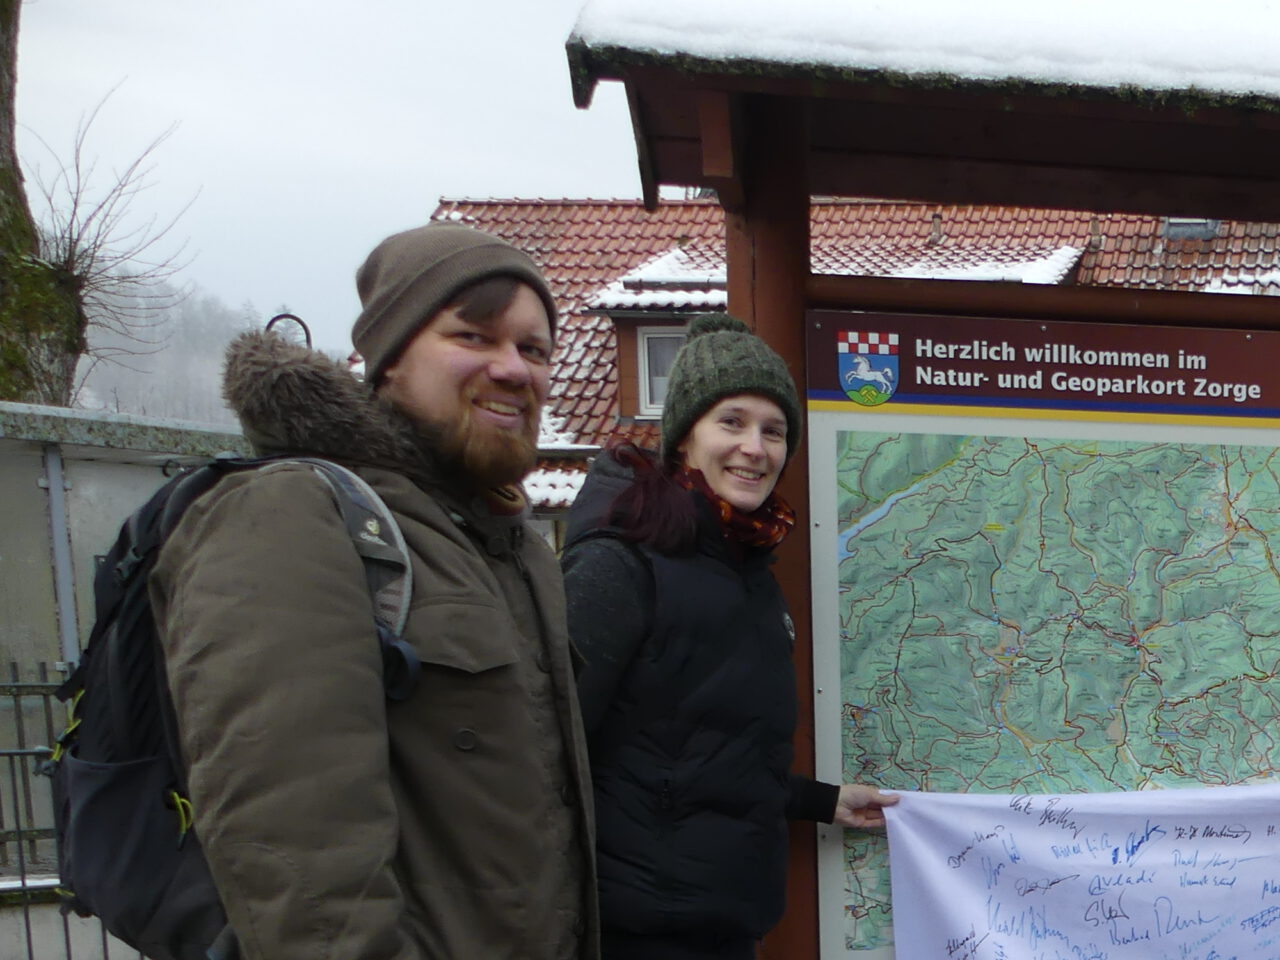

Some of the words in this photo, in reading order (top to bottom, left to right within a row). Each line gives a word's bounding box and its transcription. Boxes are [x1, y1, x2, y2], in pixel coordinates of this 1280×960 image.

[916, 339, 1015, 362] Herzlich
[1025, 345, 1170, 369] willkommen
[1178, 349, 1207, 370] im
[916, 368, 990, 389] Natur-
[997, 369, 1042, 391] und
[1052, 372, 1186, 397] Geoparkort
[1193, 378, 1261, 401] Zorge
